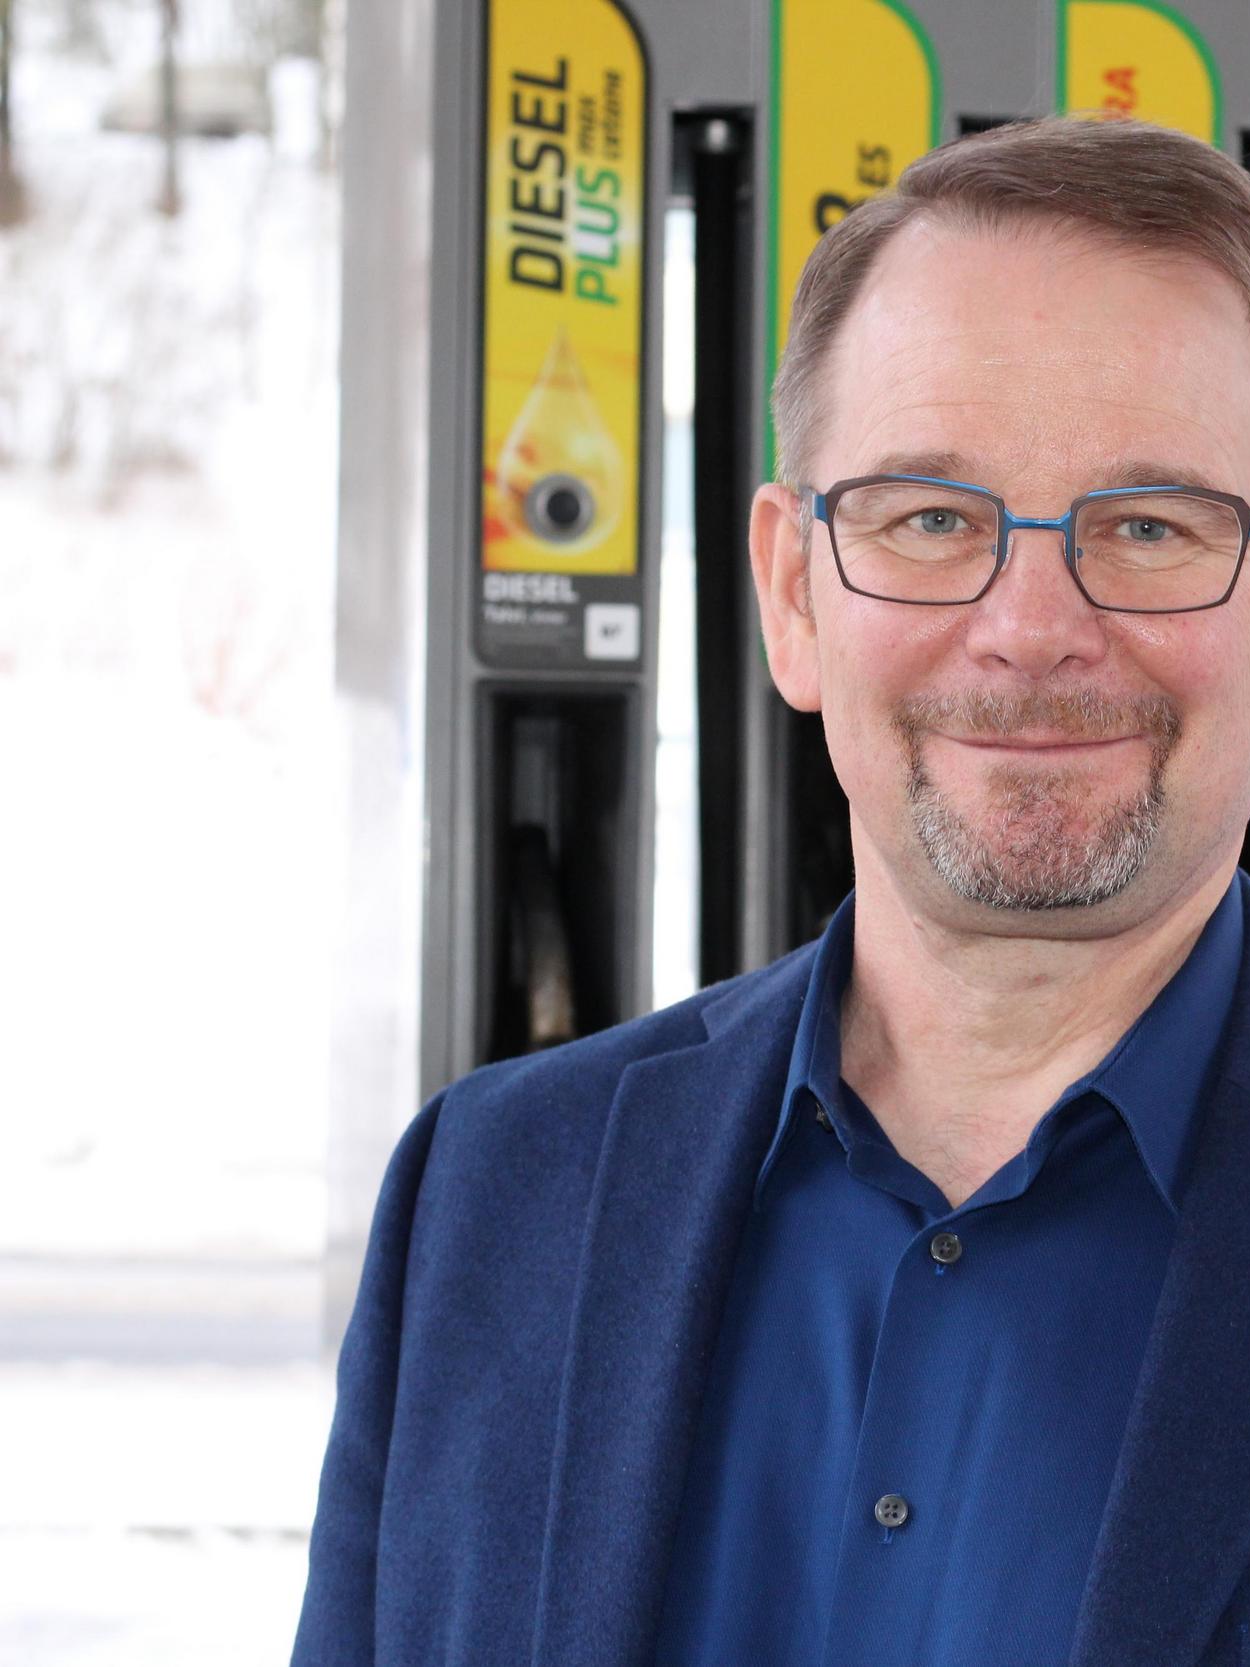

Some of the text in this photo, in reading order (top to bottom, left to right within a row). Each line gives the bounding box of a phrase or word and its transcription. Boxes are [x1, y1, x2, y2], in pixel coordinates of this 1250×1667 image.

[508, 55, 569, 294] DIESEL
[575, 164, 622, 307] PLUS
[483, 573, 579, 603] DIESEL
